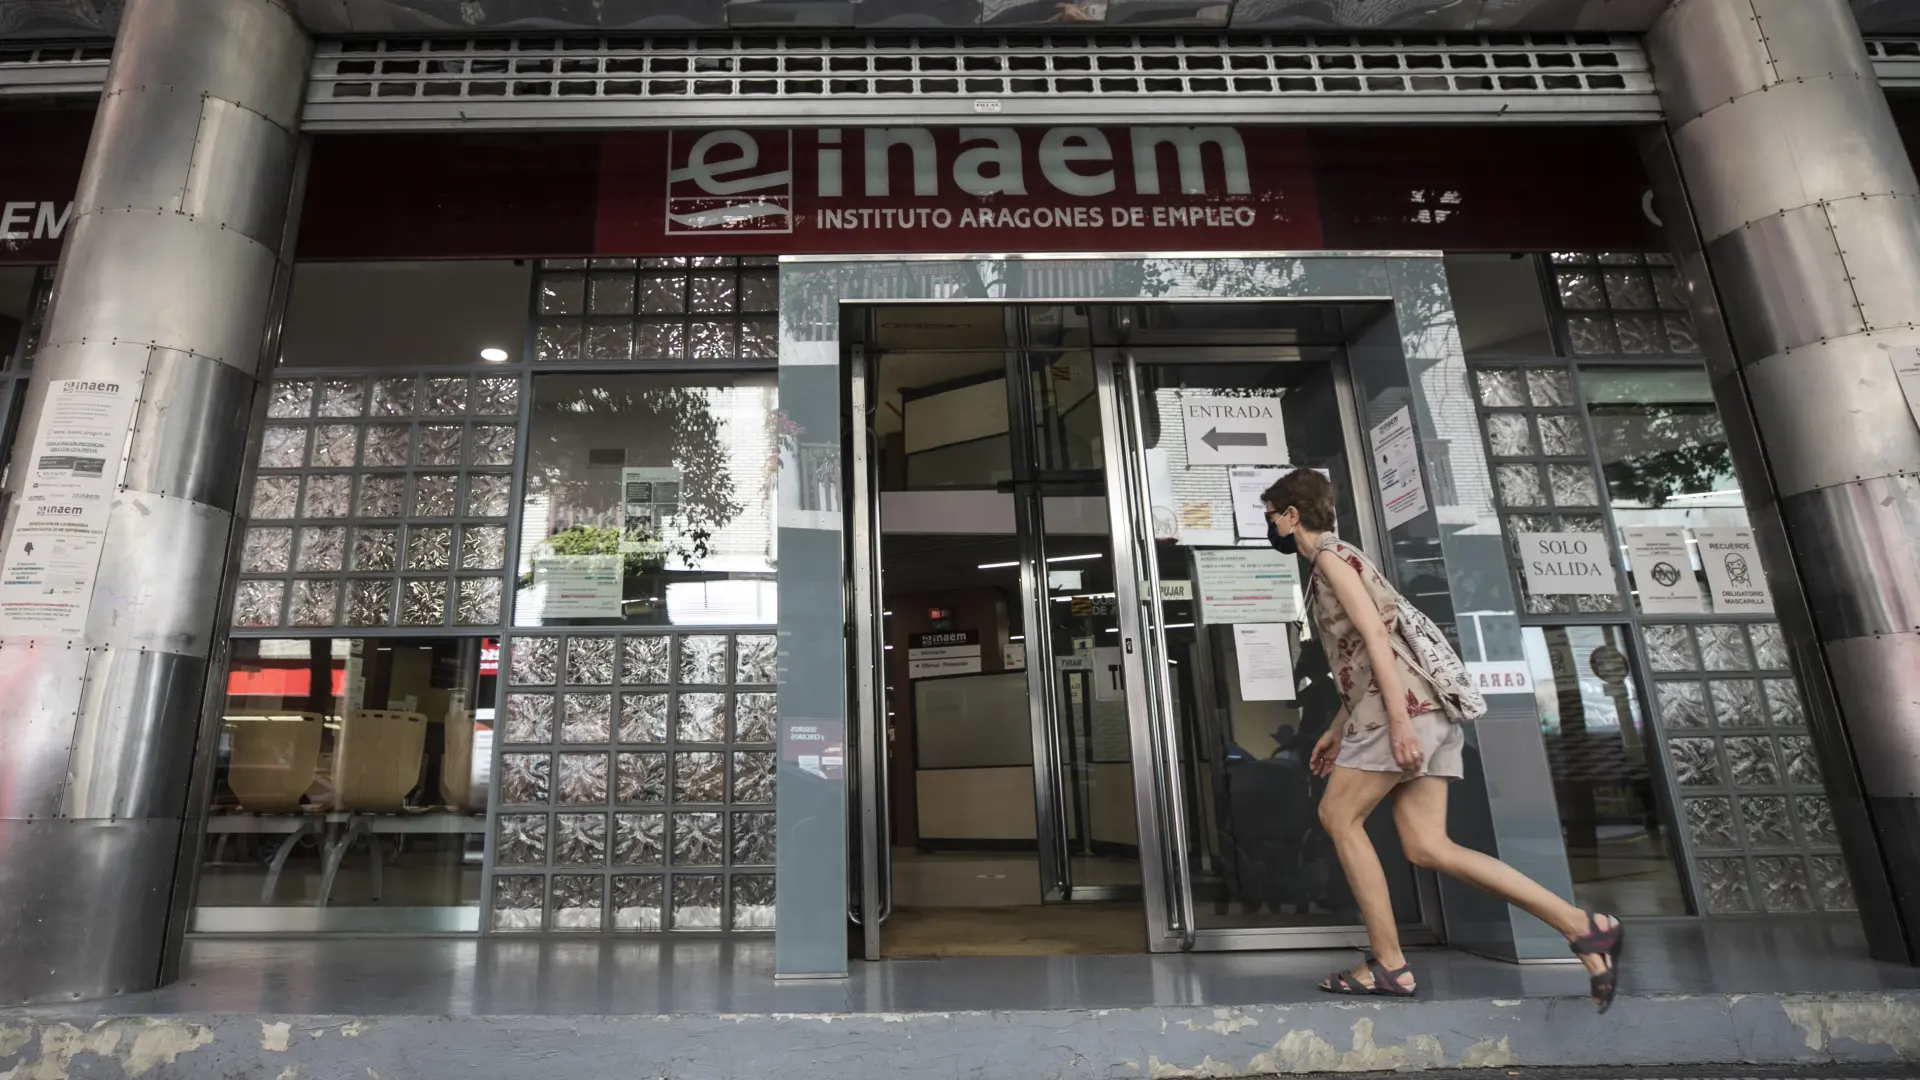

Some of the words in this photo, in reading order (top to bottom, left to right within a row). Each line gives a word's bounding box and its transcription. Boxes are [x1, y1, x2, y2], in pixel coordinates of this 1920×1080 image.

[817, 126, 1252, 197] inaem
[817, 208, 951, 229] INSTITUTO
[959, 207, 1104, 228] ARAGONES
[1111, 206, 1145, 227] DE
[1152, 206, 1256, 227] EMPLEO
[76, 381, 119, 393] inaem
[1189, 405, 1274, 419] ENTRADA
[47, 506, 83, 515] inaem
[1539, 540, 1588, 556] SOLO
[1533, 561, 1602, 577] SALIDA
[1147, 586, 1185, 597] PUJAR
[933, 633, 967, 642] inaem
